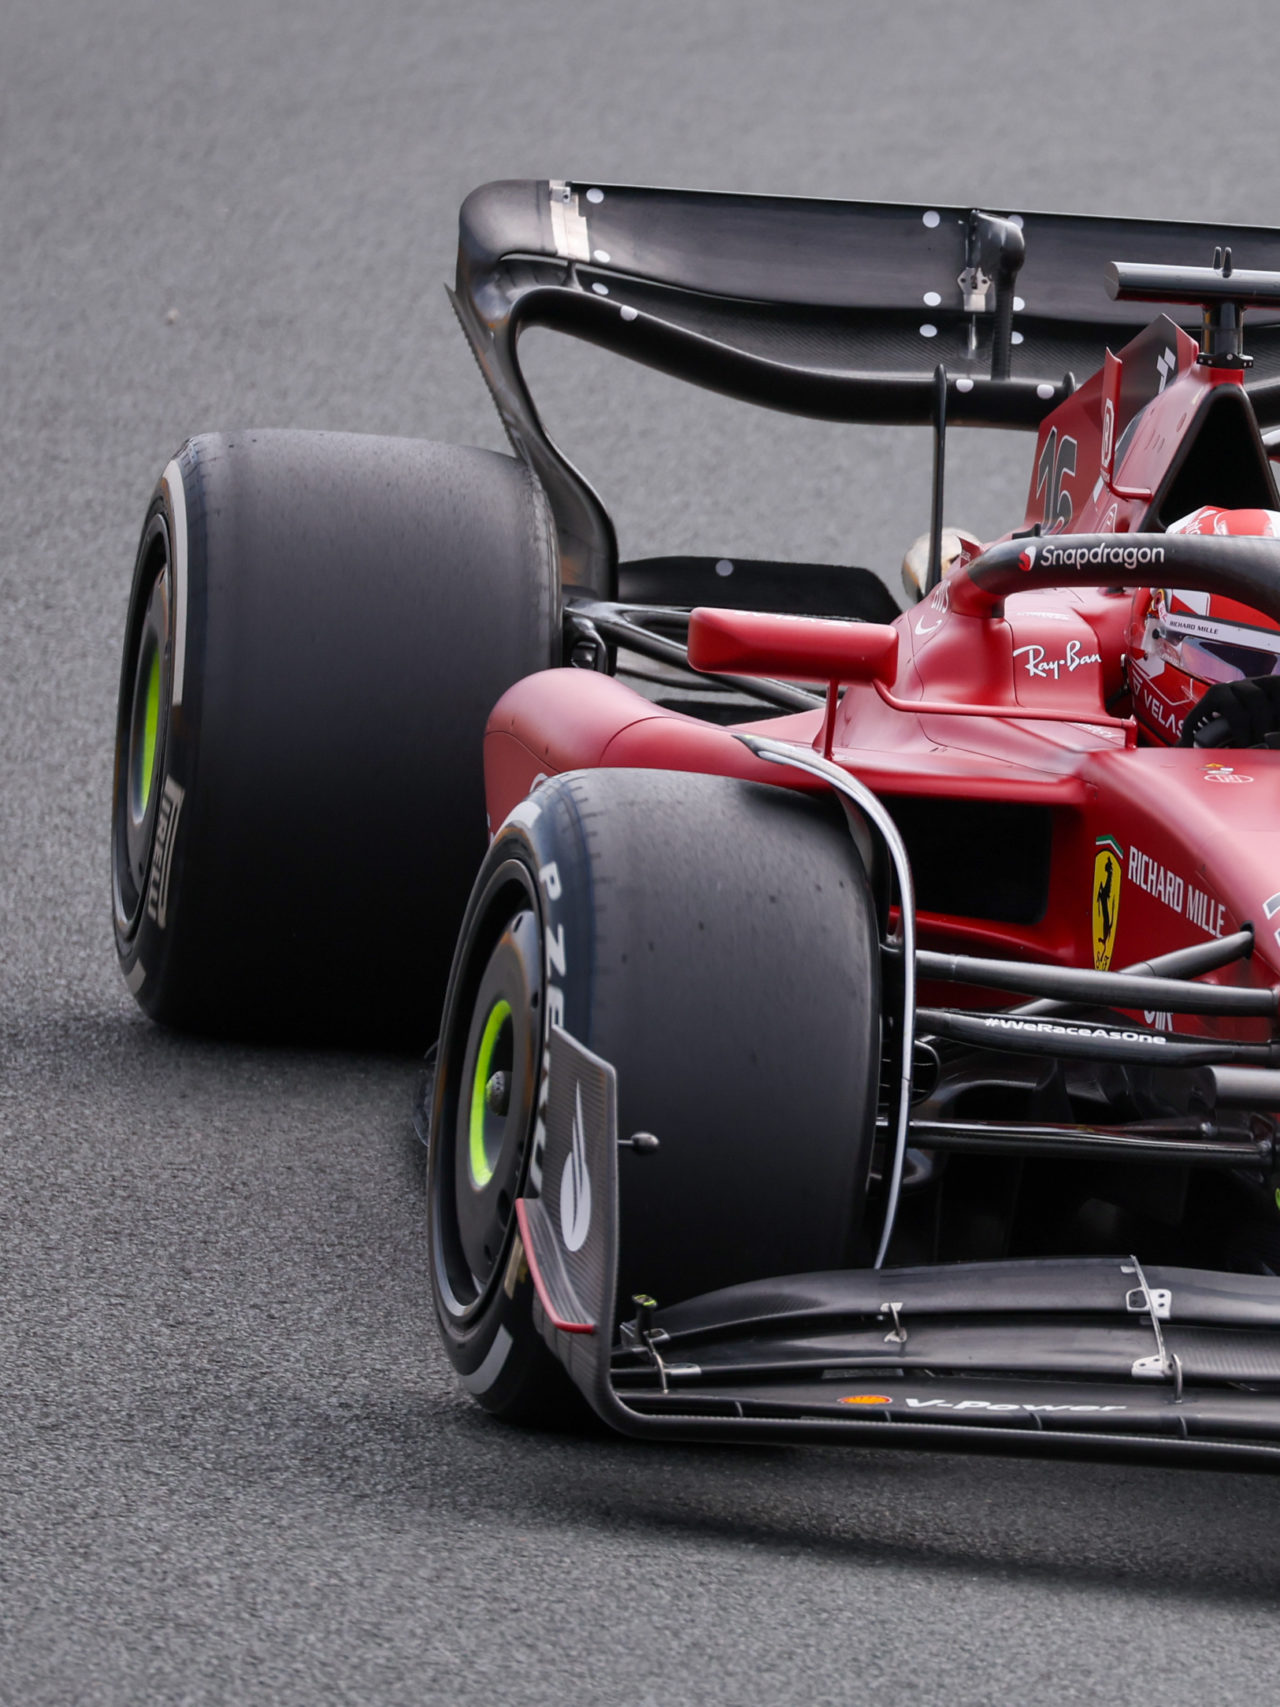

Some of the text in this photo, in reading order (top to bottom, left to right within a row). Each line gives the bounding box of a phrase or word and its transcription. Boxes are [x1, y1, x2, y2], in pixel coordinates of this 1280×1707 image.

[1036, 425, 1077, 535] 16
[1041, 542, 1165, 570] Snapdragon
[1169, 620, 1219, 635] RICHARD MILLE
[148, 773, 186, 930] PIRELLI
[1128, 845, 1226, 940] RICHARD MILLE
[985, 1018, 1166, 1045] #WeRaceAsOne
[905, 1398, 1127, 1412] V-Power
